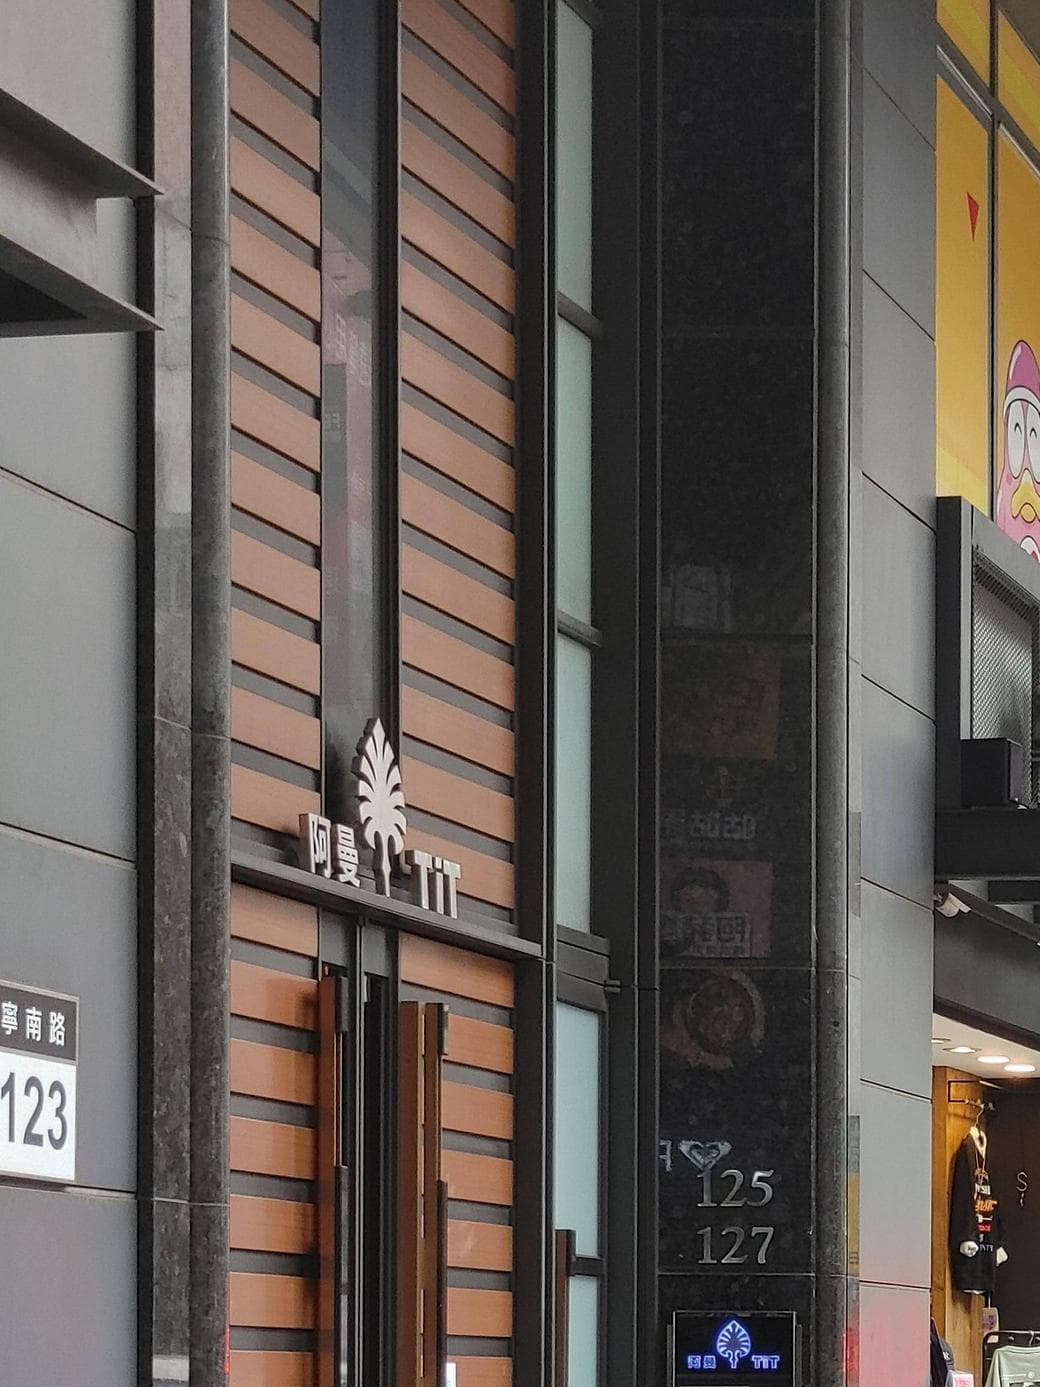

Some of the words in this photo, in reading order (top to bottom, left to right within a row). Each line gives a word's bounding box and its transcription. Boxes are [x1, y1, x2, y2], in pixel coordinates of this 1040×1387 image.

[0, 1071, 68, 1151] 123
[697, 1168, 776, 1207] 125
[697, 1226, 775, 1265] 127
